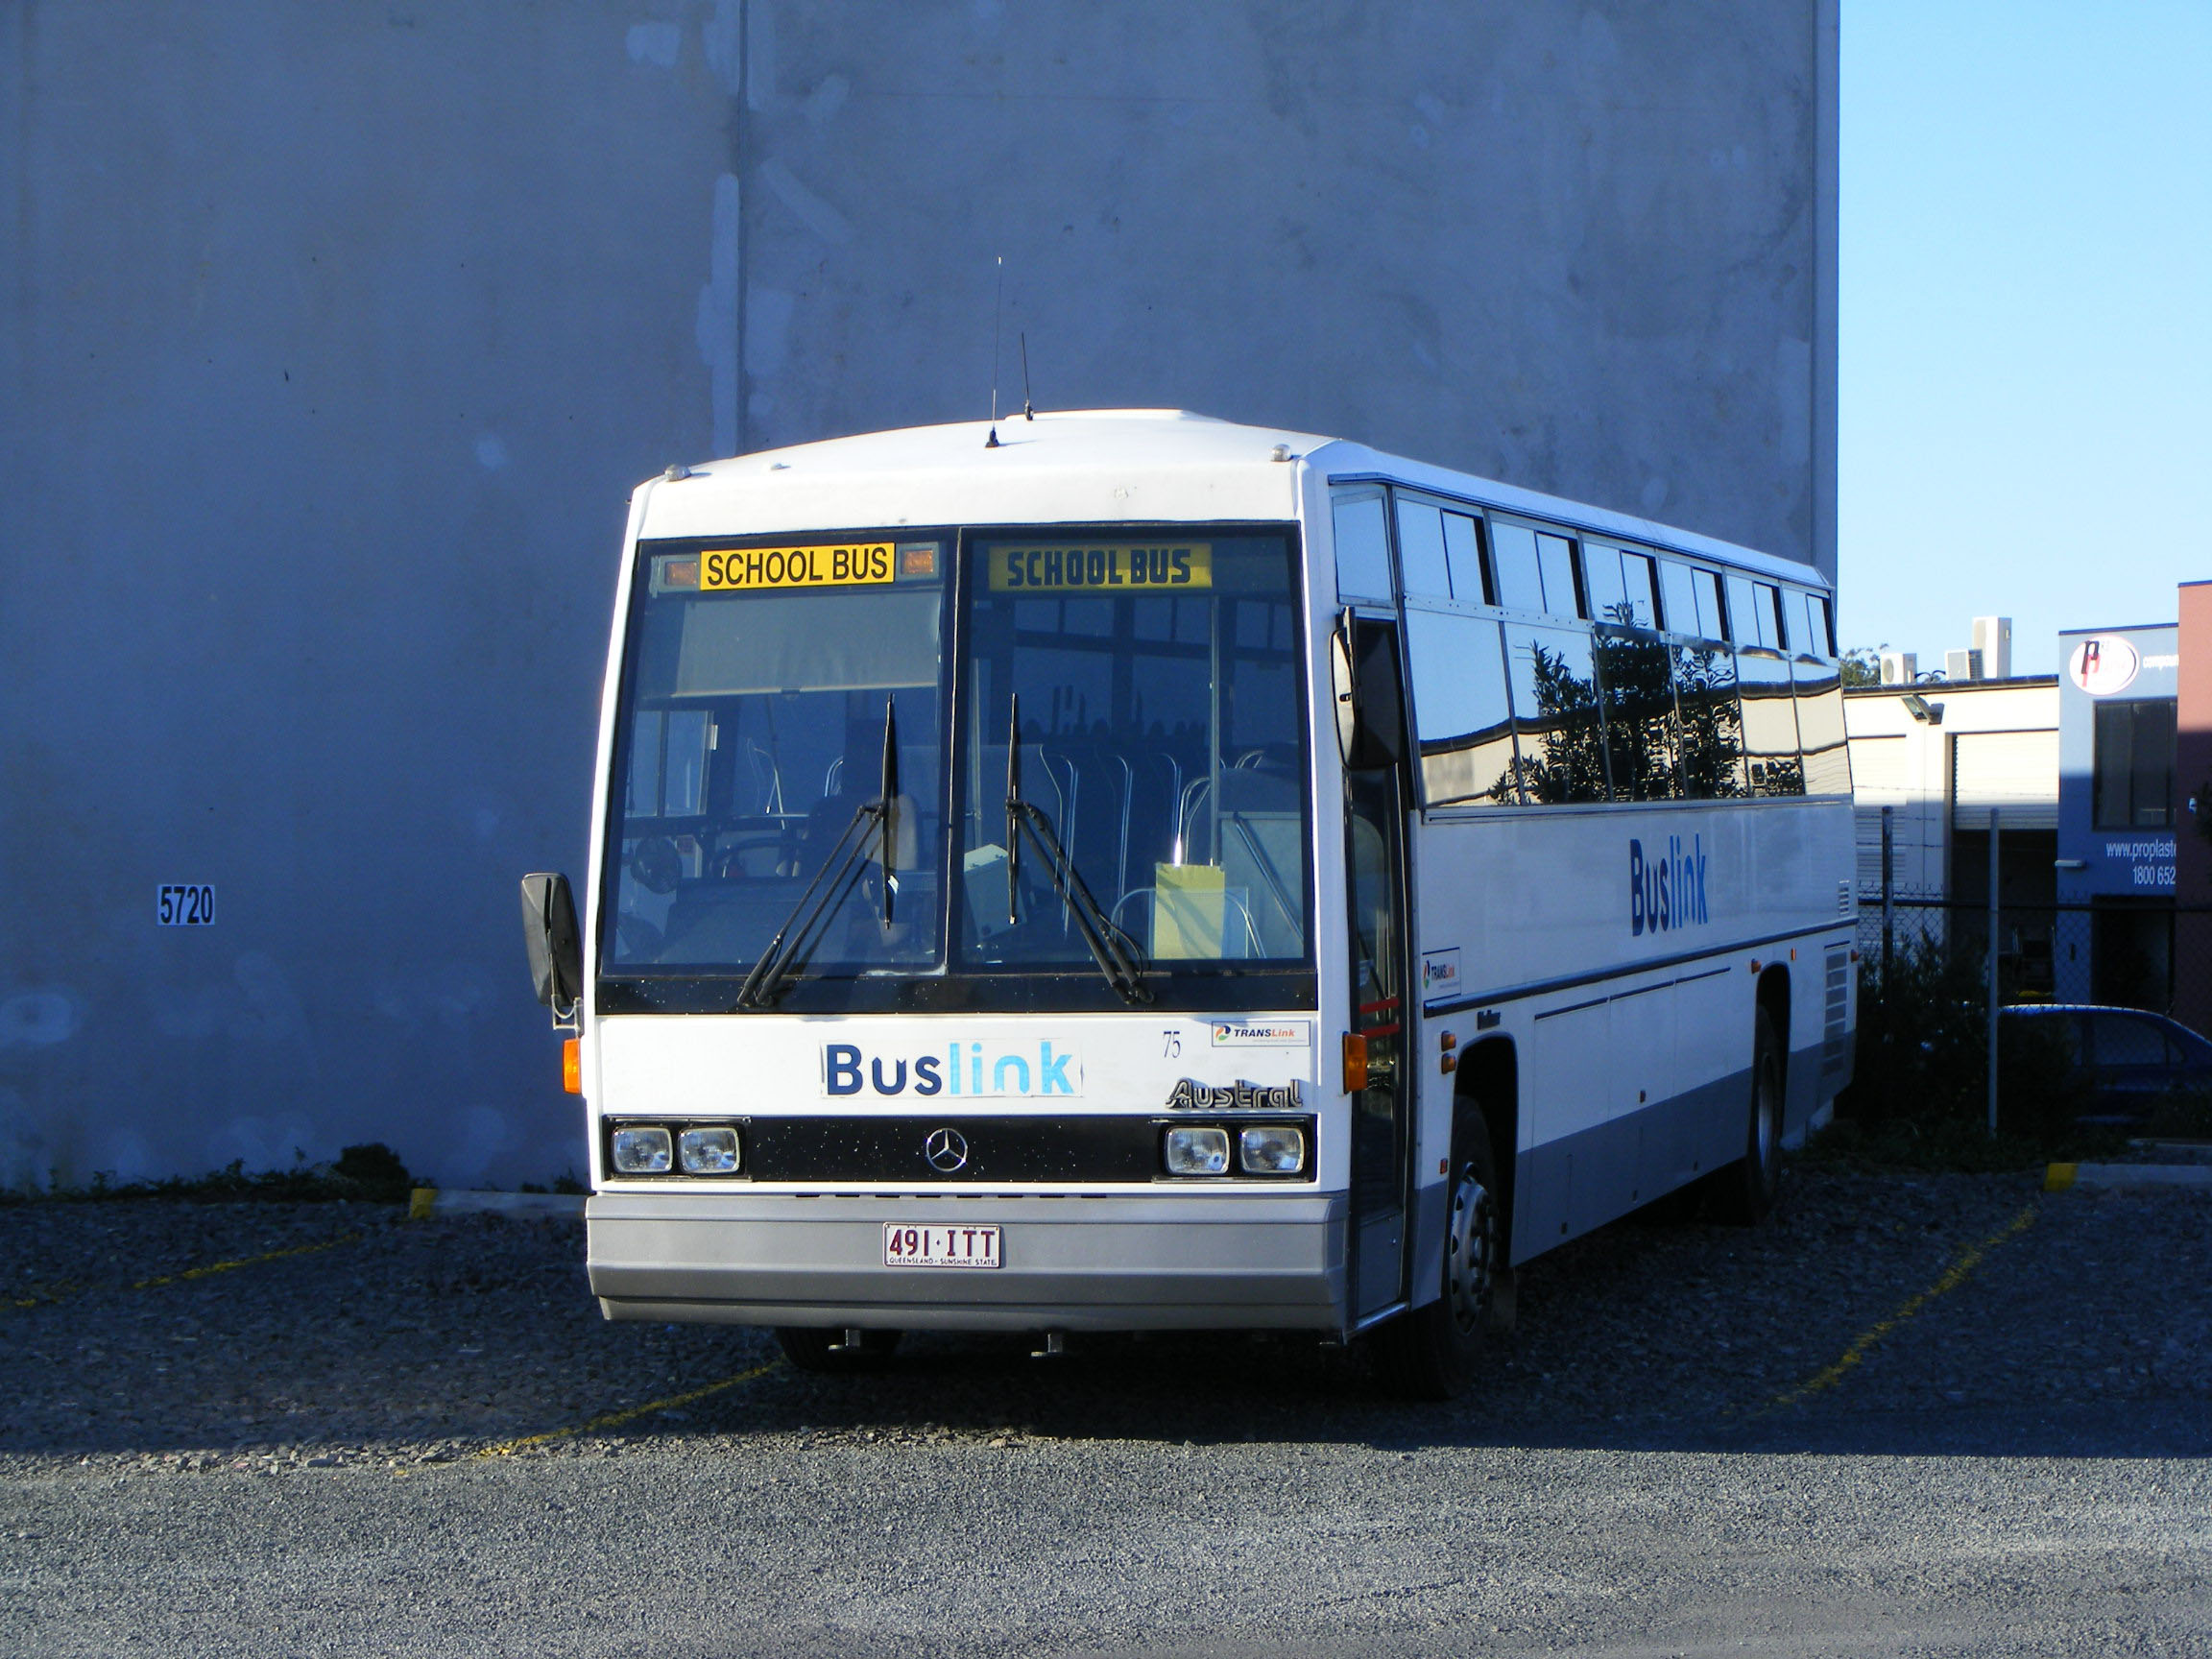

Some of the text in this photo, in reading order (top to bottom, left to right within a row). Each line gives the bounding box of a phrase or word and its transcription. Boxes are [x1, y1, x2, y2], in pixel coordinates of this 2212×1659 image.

[707, 546, 888, 587] SCHOOL BUS
[1007, 548, 1191, 587] SCHOOL BUS
[1629, 833, 1708, 937] Buslink
[2132, 866, 2176, 884] 1800 652
[160, 885, 213, 924] 5720
[1163, 1031, 1181, 1058] 75
[1234, 1028, 1296, 1038] TRANSLink
[827, 1042, 1074, 1095] Buslink
[1166, 1077, 1303, 1109] Austral
